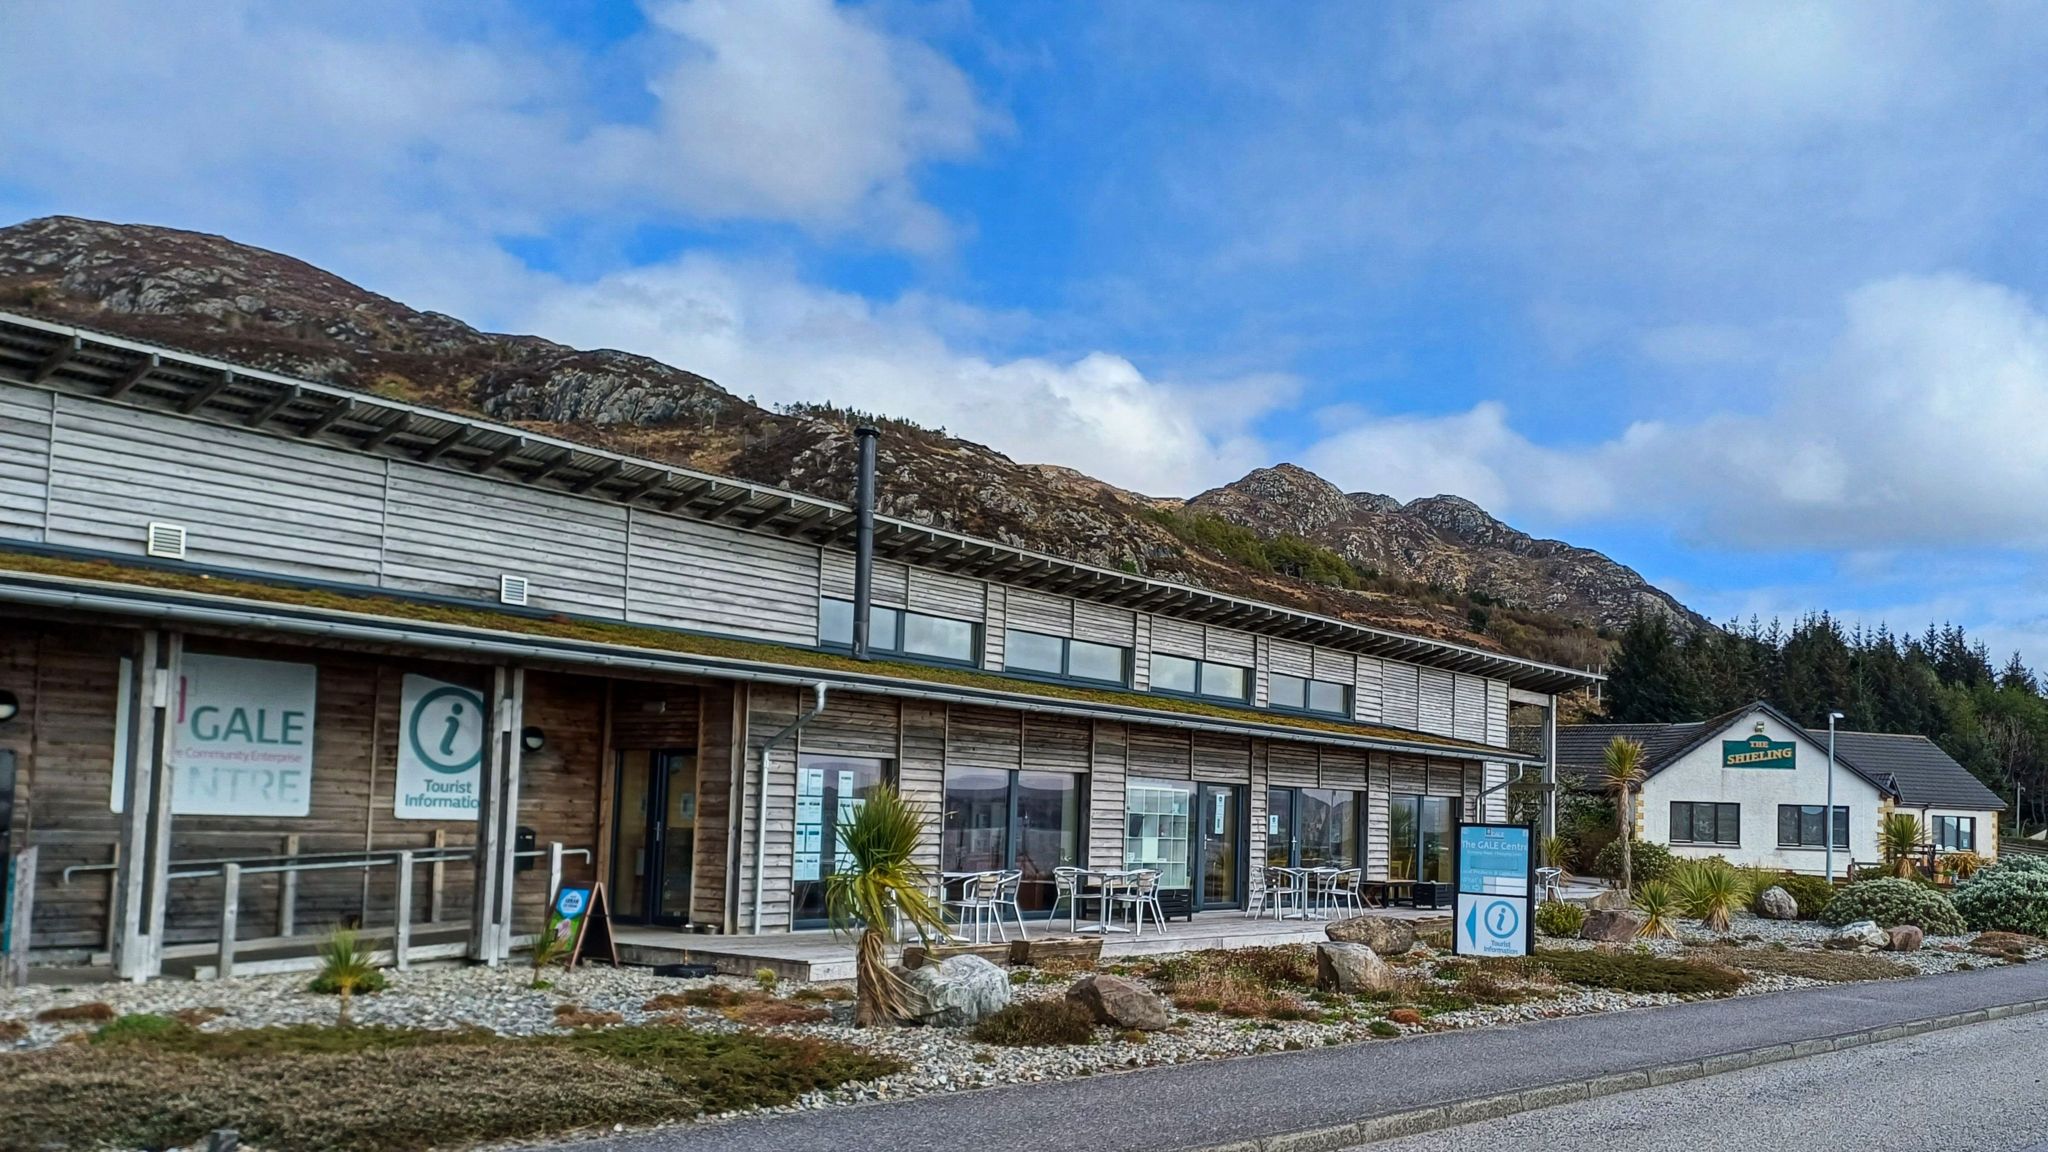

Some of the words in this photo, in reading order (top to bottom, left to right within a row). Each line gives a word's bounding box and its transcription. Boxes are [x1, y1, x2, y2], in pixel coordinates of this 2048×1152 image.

[190, 705, 306, 745] GALE
[186, 747, 248, 763] Community
[250, 751, 304, 764] Enterprise
[1727, 748, 1793, 765] SHIELING
[188, 766, 302, 803] NTRE
[424, 779, 473, 794] Tourist
[404, 793, 481, 809] Informatio
[1462, 840, 1476, 849] The
[1477, 840, 1499, 850] GALE
[1484, 946, 1519, 955] Information
[1491, 940, 1511, 948] Tourist
